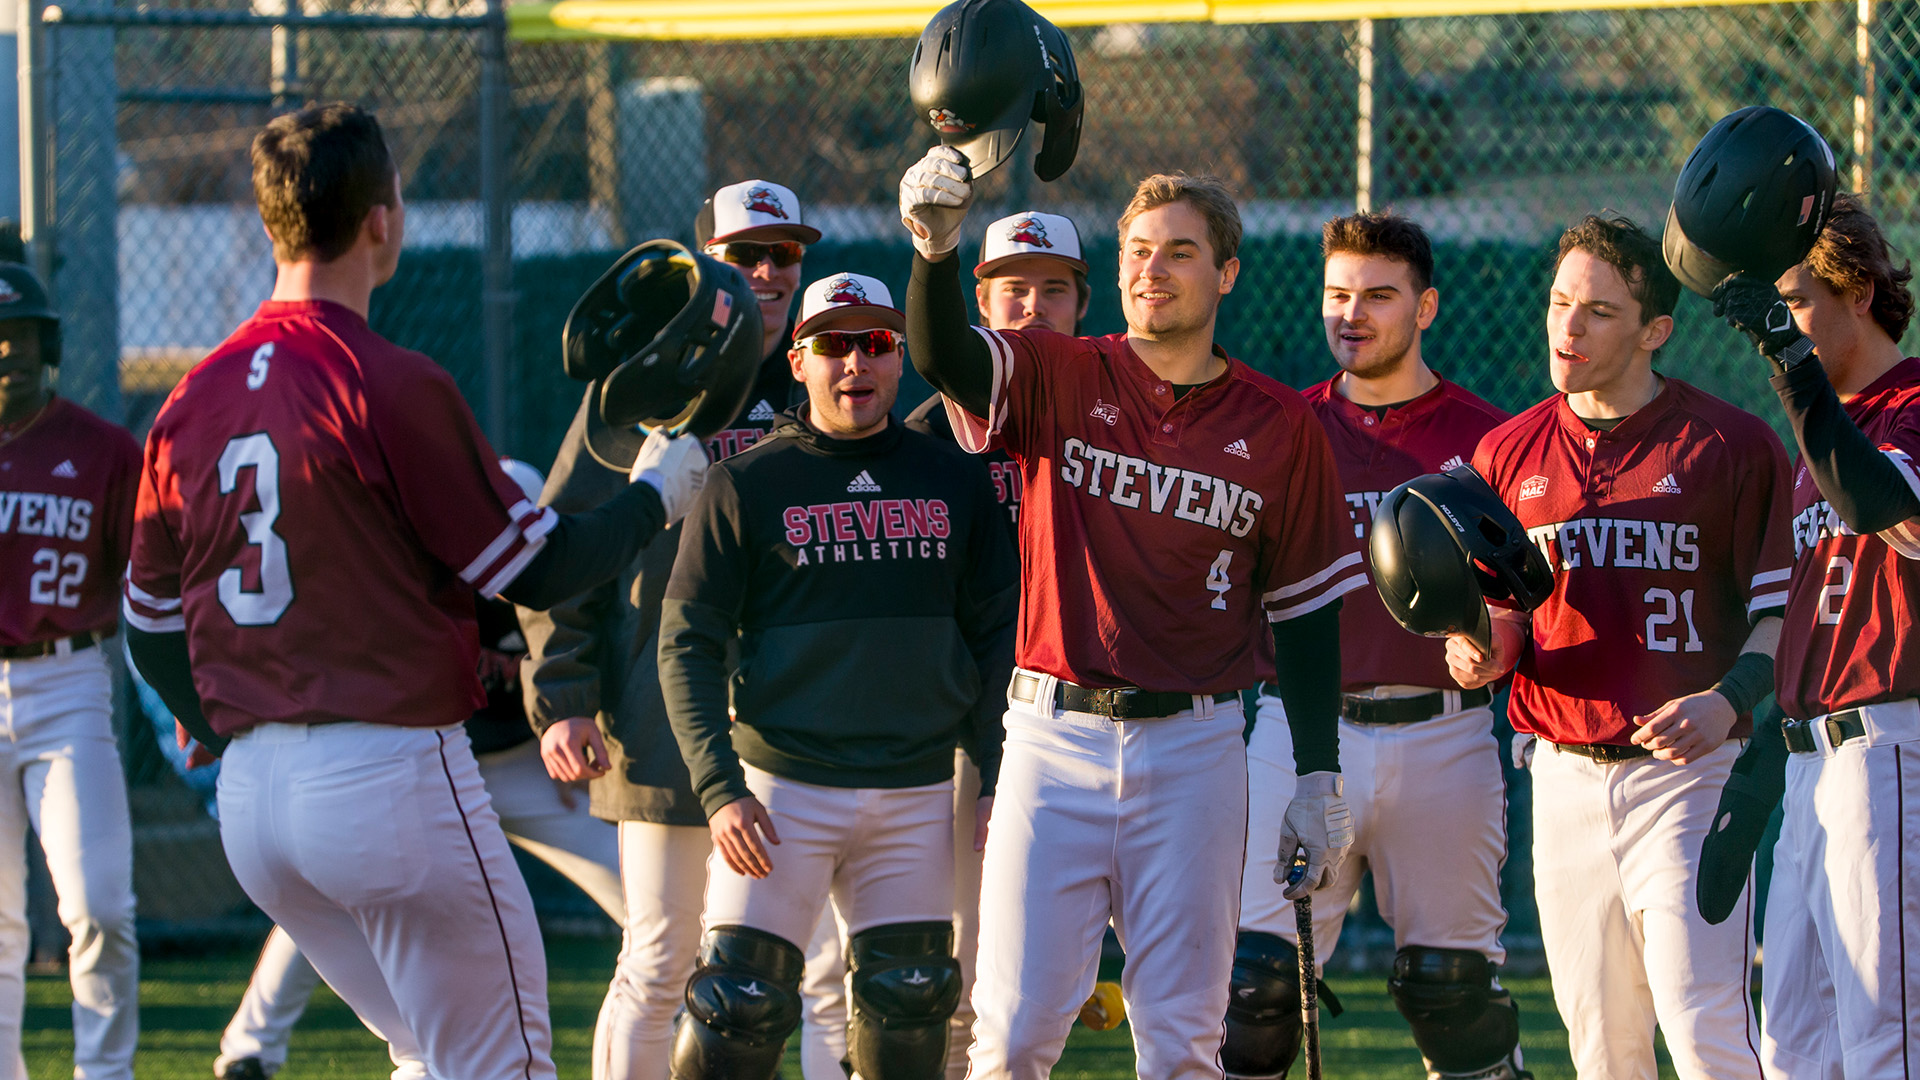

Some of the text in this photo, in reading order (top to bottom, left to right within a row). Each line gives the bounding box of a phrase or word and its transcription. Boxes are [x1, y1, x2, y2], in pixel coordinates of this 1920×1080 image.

[246, 340, 275, 391] S
[1223, 446, 1251, 460] adidas
[847, 484, 882, 492] adidas
[1060, 437, 1264, 538] STEVENS
[1521, 485, 1545, 498] MAC
[1652, 485, 1682, 494] adidas
[217, 432, 294, 626] 3
[782, 498, 951, 546] STEVENS
[1440, 504, 1465, 533] EASTON
[796, 540, 946, 566] ATHLETICS
[30, 548, 89, 608] 22
[1205, 549, 1234, 611] 4
[1644, 586, 1703, 653] 21
